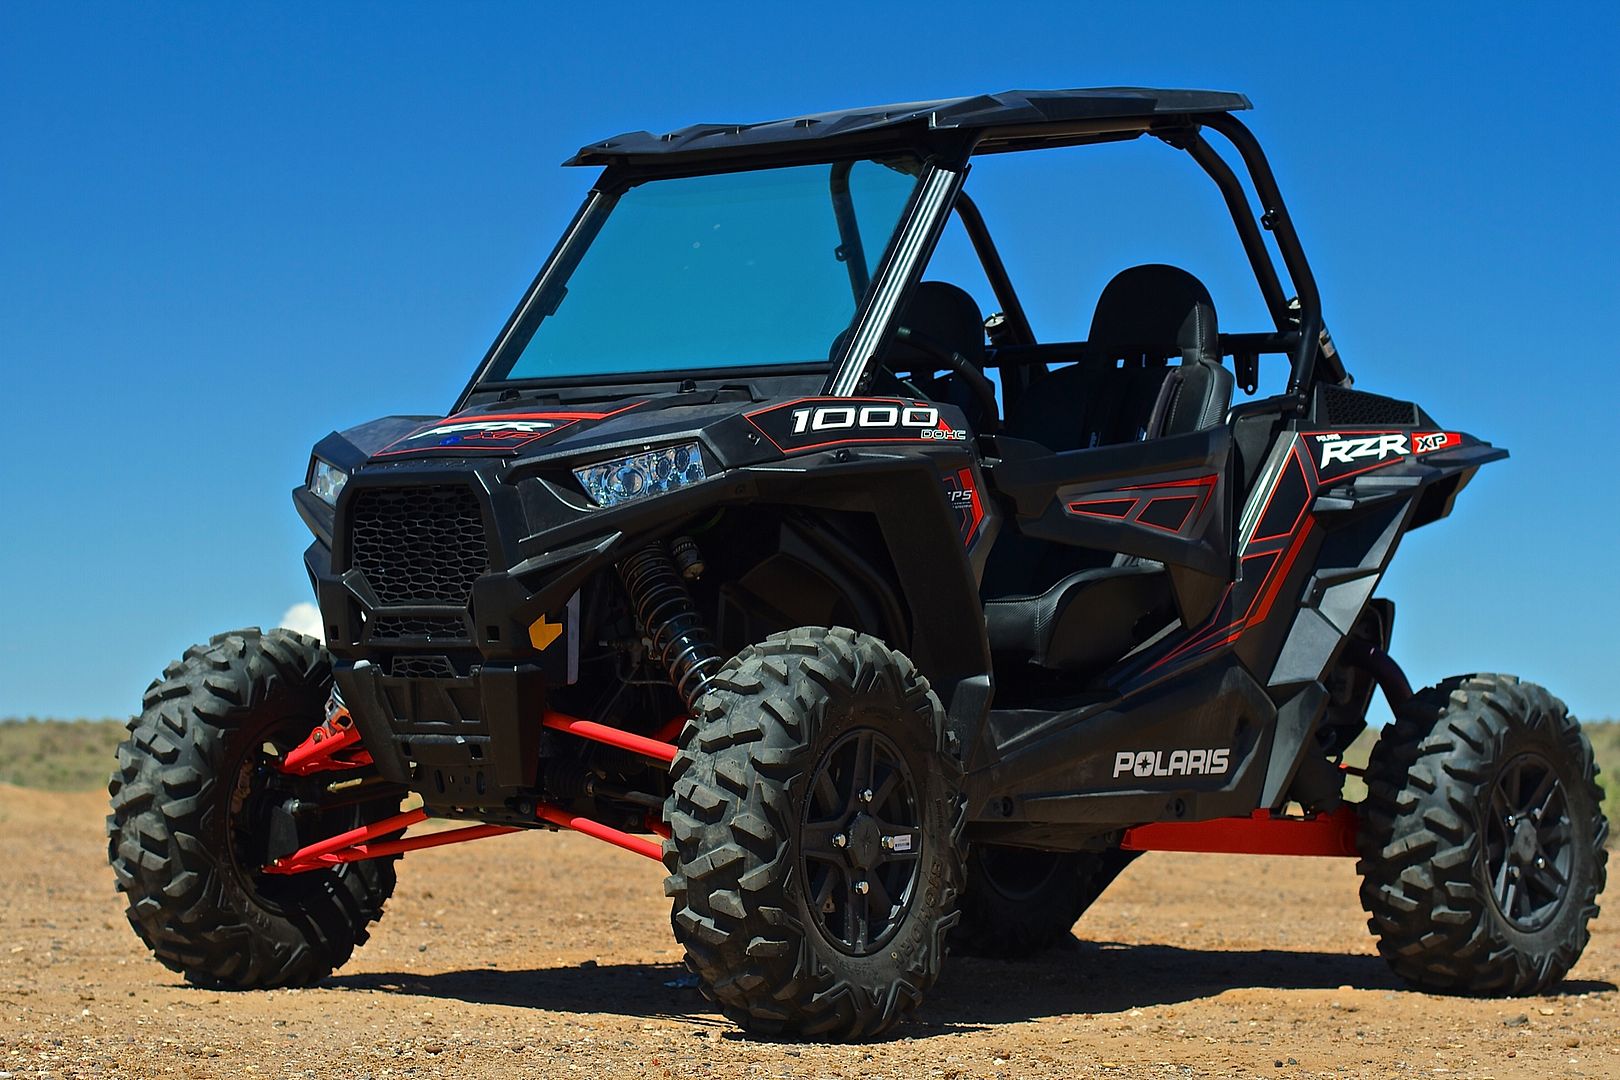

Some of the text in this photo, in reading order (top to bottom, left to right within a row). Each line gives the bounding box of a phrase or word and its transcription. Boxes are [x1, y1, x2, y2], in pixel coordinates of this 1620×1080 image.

[793, 407, 939, 433] 1000
[920, 429, 966, 440] DOHC
[1320, 433, 1448, 470] RZR XP
[1112, 748, 1230, 778] POLARIS
